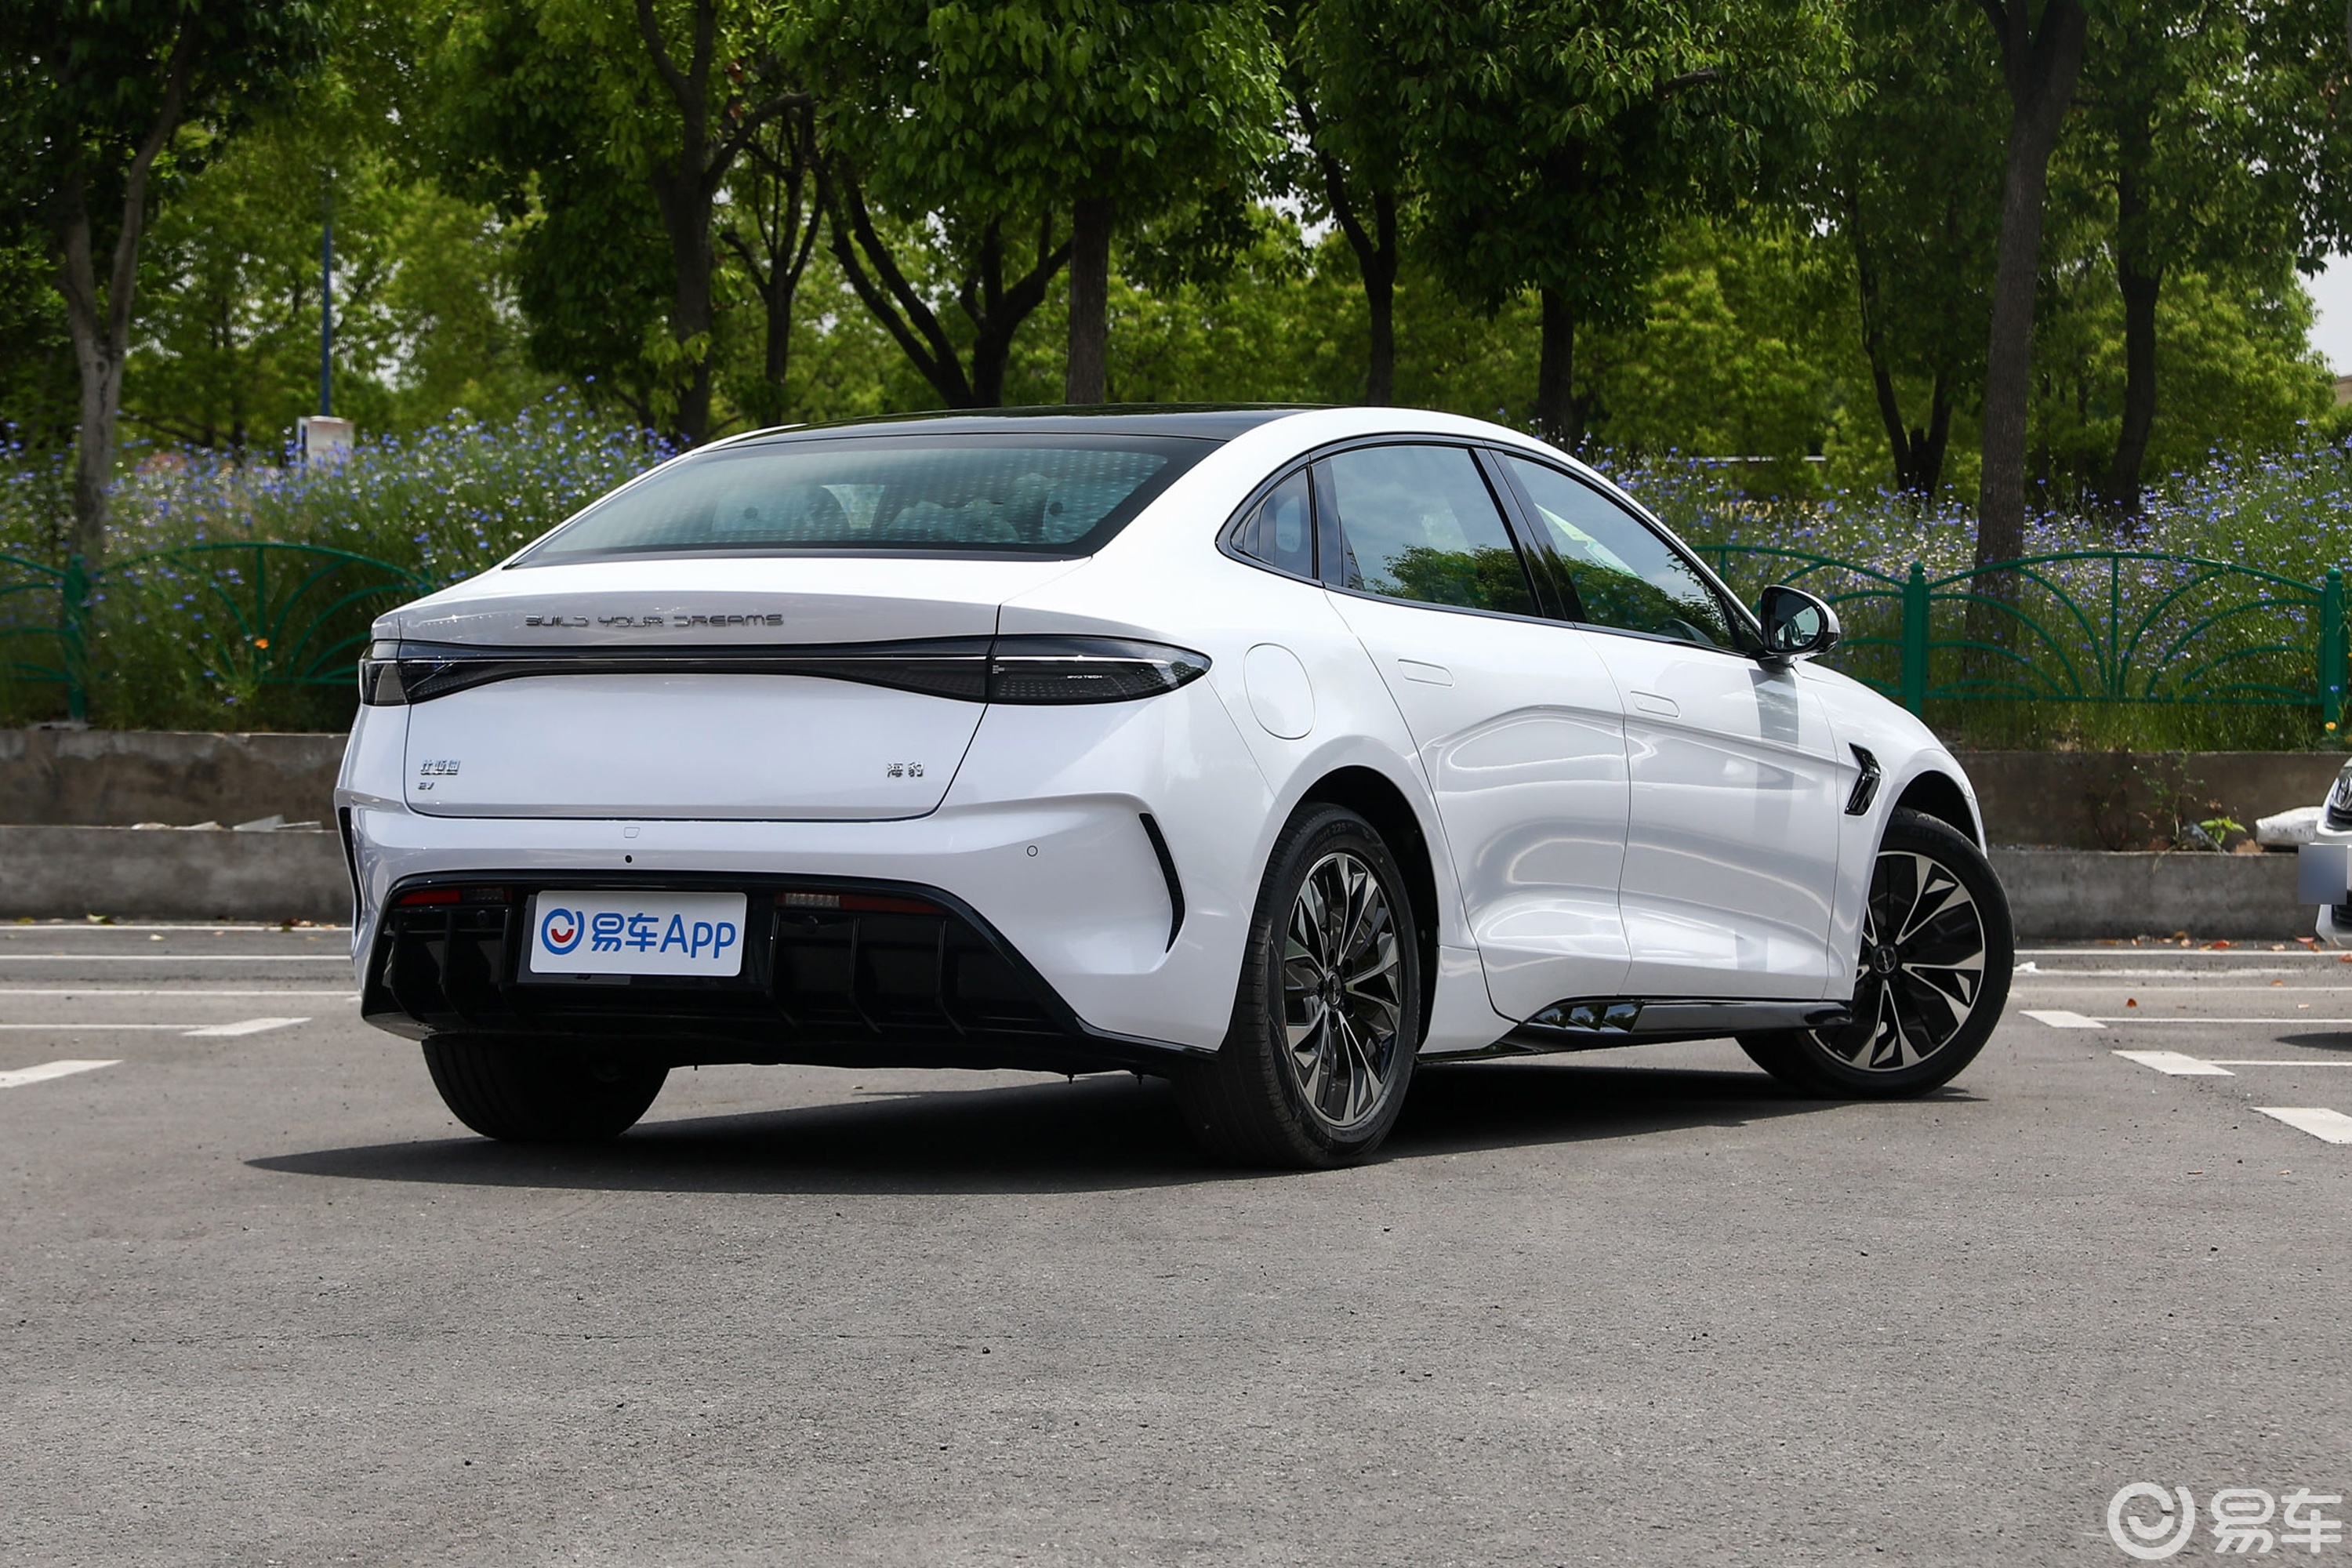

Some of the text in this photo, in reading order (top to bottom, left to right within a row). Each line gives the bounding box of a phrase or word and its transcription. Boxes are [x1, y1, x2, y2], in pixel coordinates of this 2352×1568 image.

[525, 613, 783, 627] BUILD YOUR DREAMS
[887, 761, 924, 778] 海豹
